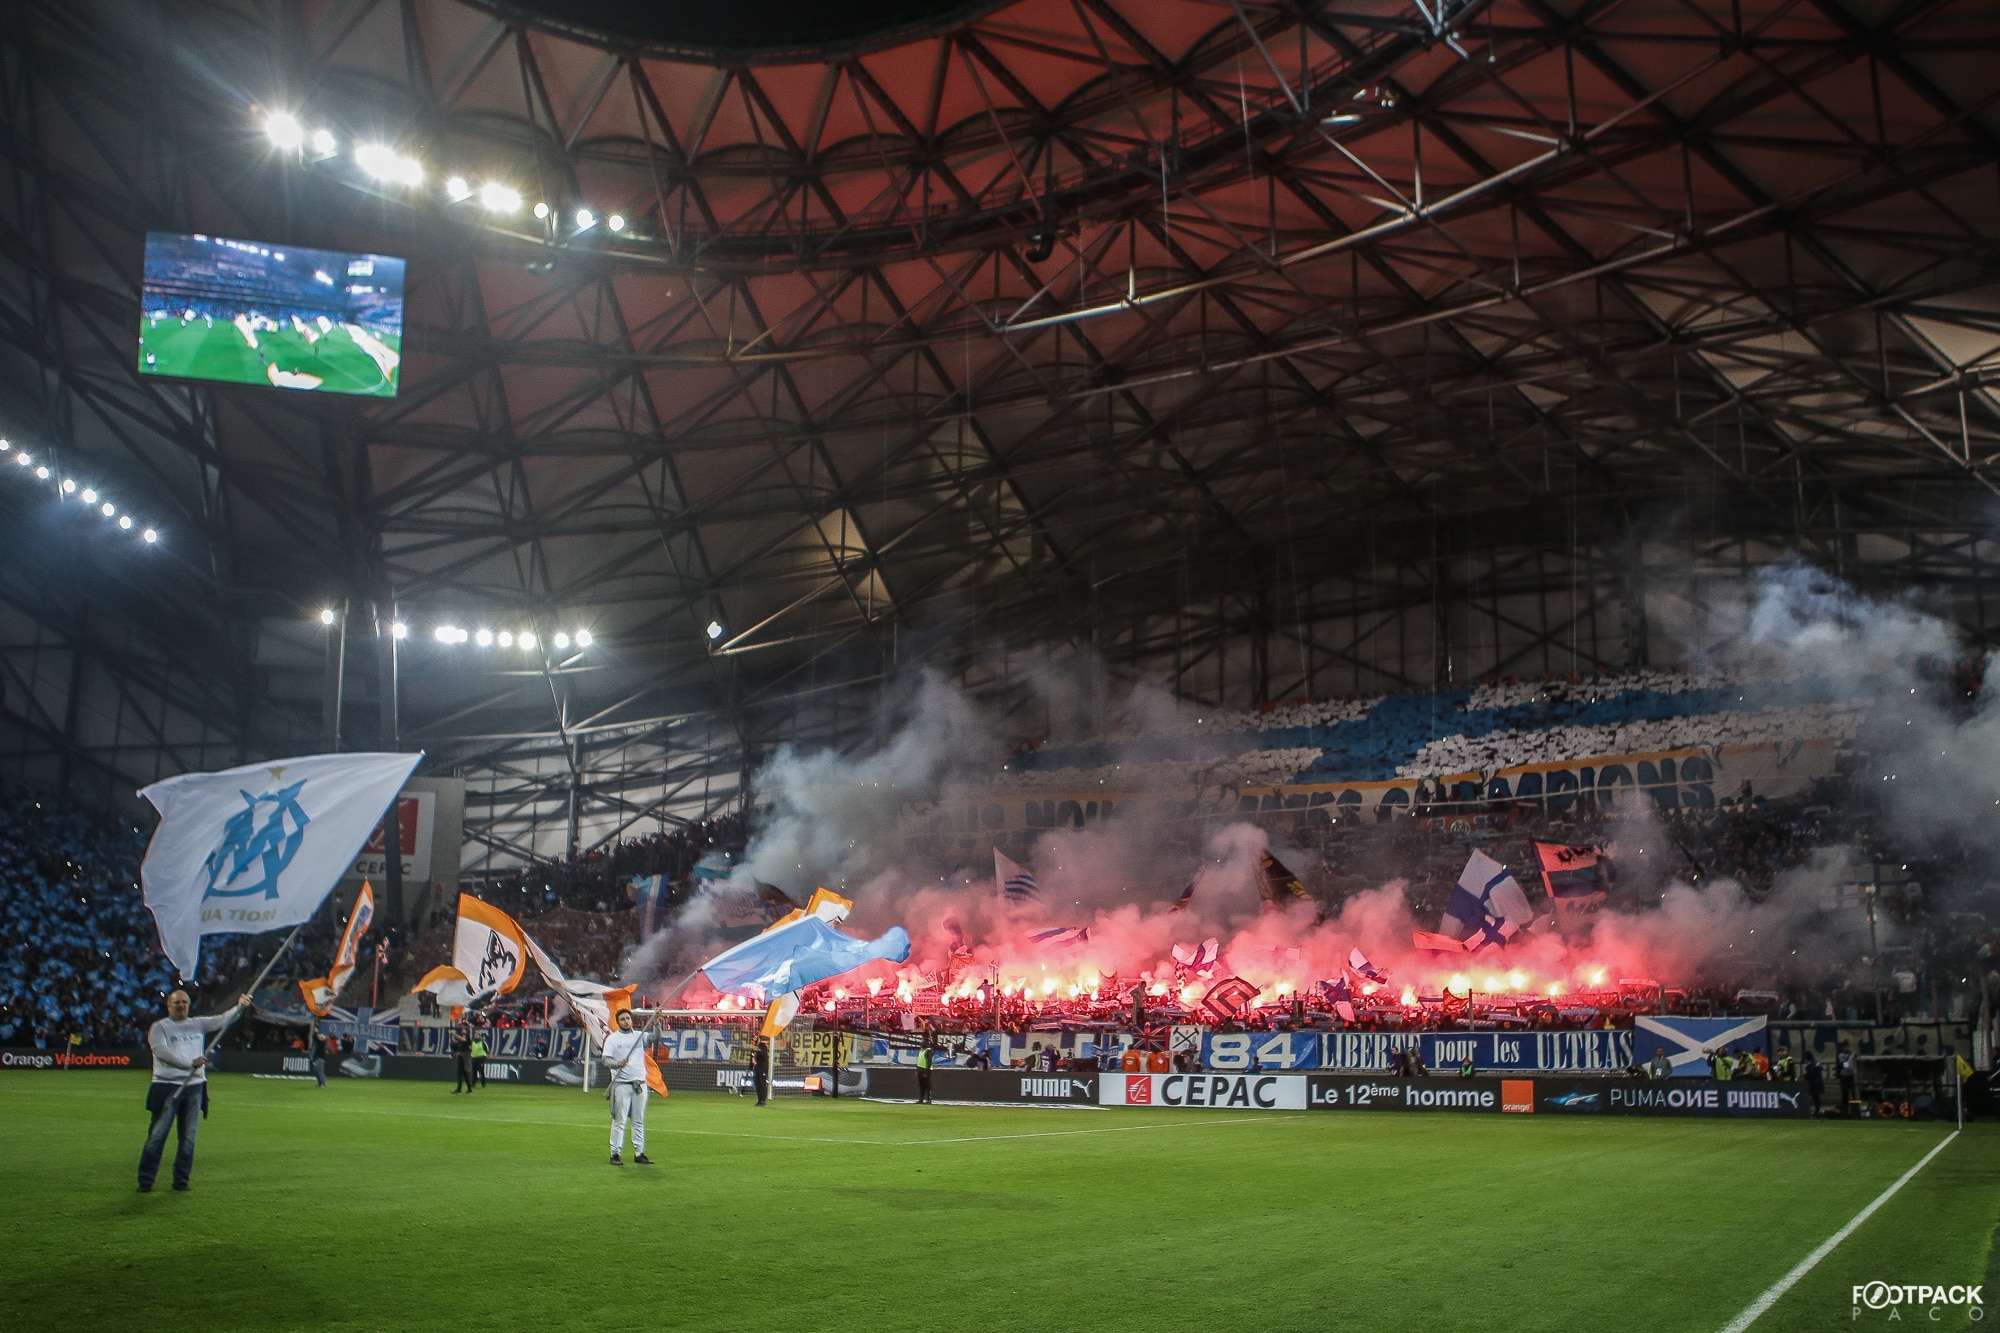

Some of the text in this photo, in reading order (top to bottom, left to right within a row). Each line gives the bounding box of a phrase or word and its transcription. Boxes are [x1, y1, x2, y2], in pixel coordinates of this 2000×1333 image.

[355, 861, 411, 875] CEPC
[2, 1052, 53, 1068] Orange
[1209, 1033, 1297, 1069] 84
[1435, 1040, 1477, 1069] pour
[1493, 1034, 1520, 1063] les
[1536, 1032, 1634, 1069] ULTRAS
[282, 1057, 310, 1072] PUMA
[1021, 1078, 1071, 1097] PUMA
[1161, 1076, 1277, 1108] CEPAC
[1311, 1083, 1495, 1107] Le 12ème homme
[1503, 1104, 1530, 1112] orange
[1727, 1090, 1780, 1109] PUMA
